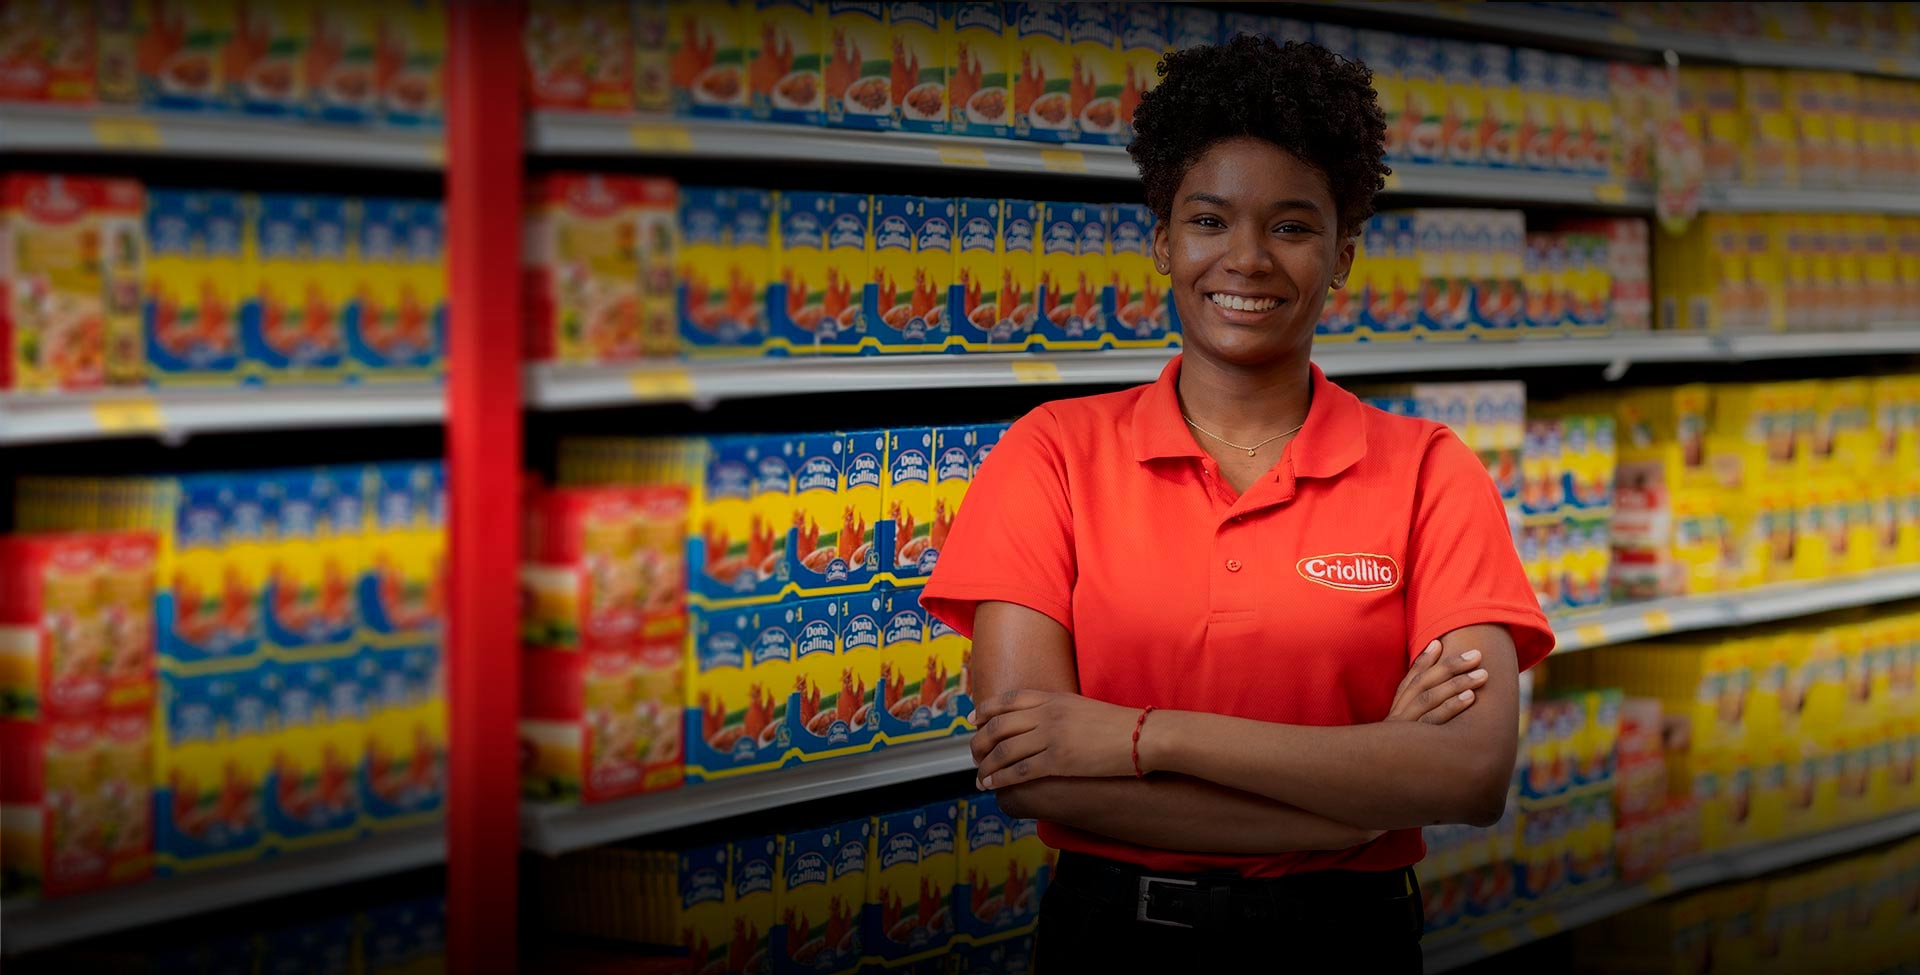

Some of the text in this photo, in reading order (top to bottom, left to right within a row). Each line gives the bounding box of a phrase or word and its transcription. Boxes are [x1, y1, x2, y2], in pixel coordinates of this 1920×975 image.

[855, 457, 875, 470] Doña
[901, 453, 923, 467] Doña
[849, 469, 879, 486] Gallina
[894, 465, 927, 482] Gallina
[1305, 558, 1392, 582] Criollito
[806, 623, 828, 639] Doña
[852, 619, 873, 632] Doña
[800, 637, 833, 654] Gallina
[846, 631, 878, 648] Gallina
